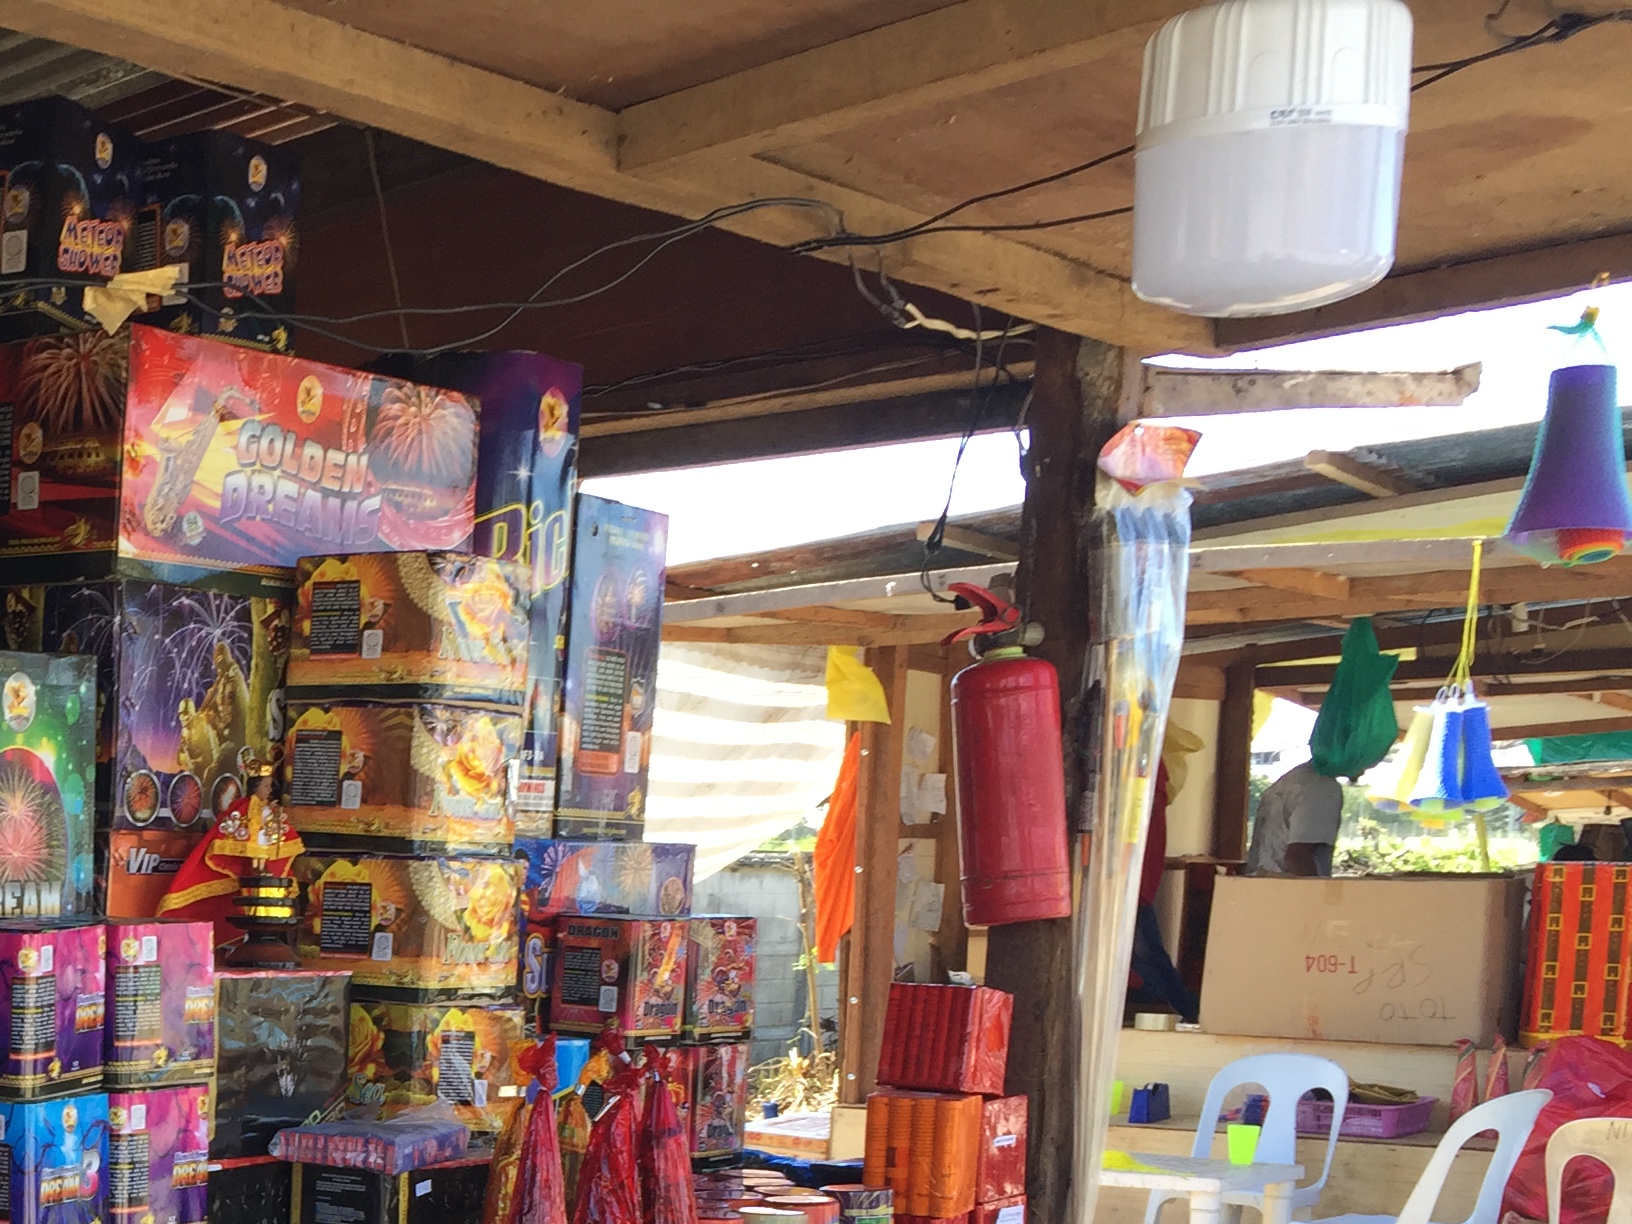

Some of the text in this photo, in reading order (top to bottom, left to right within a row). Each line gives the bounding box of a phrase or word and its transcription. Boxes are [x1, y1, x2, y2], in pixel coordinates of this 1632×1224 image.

[237, 419, 368, 494] GOLDEN
[220, 470, 382, 546] DREAMS
[128, 848, 160, 874] VIP
[568, 924, 618, 939] DRAGON
[1304, 954, 1358, 975] T-604
[643, 1000, 678, 1018] Dragon
